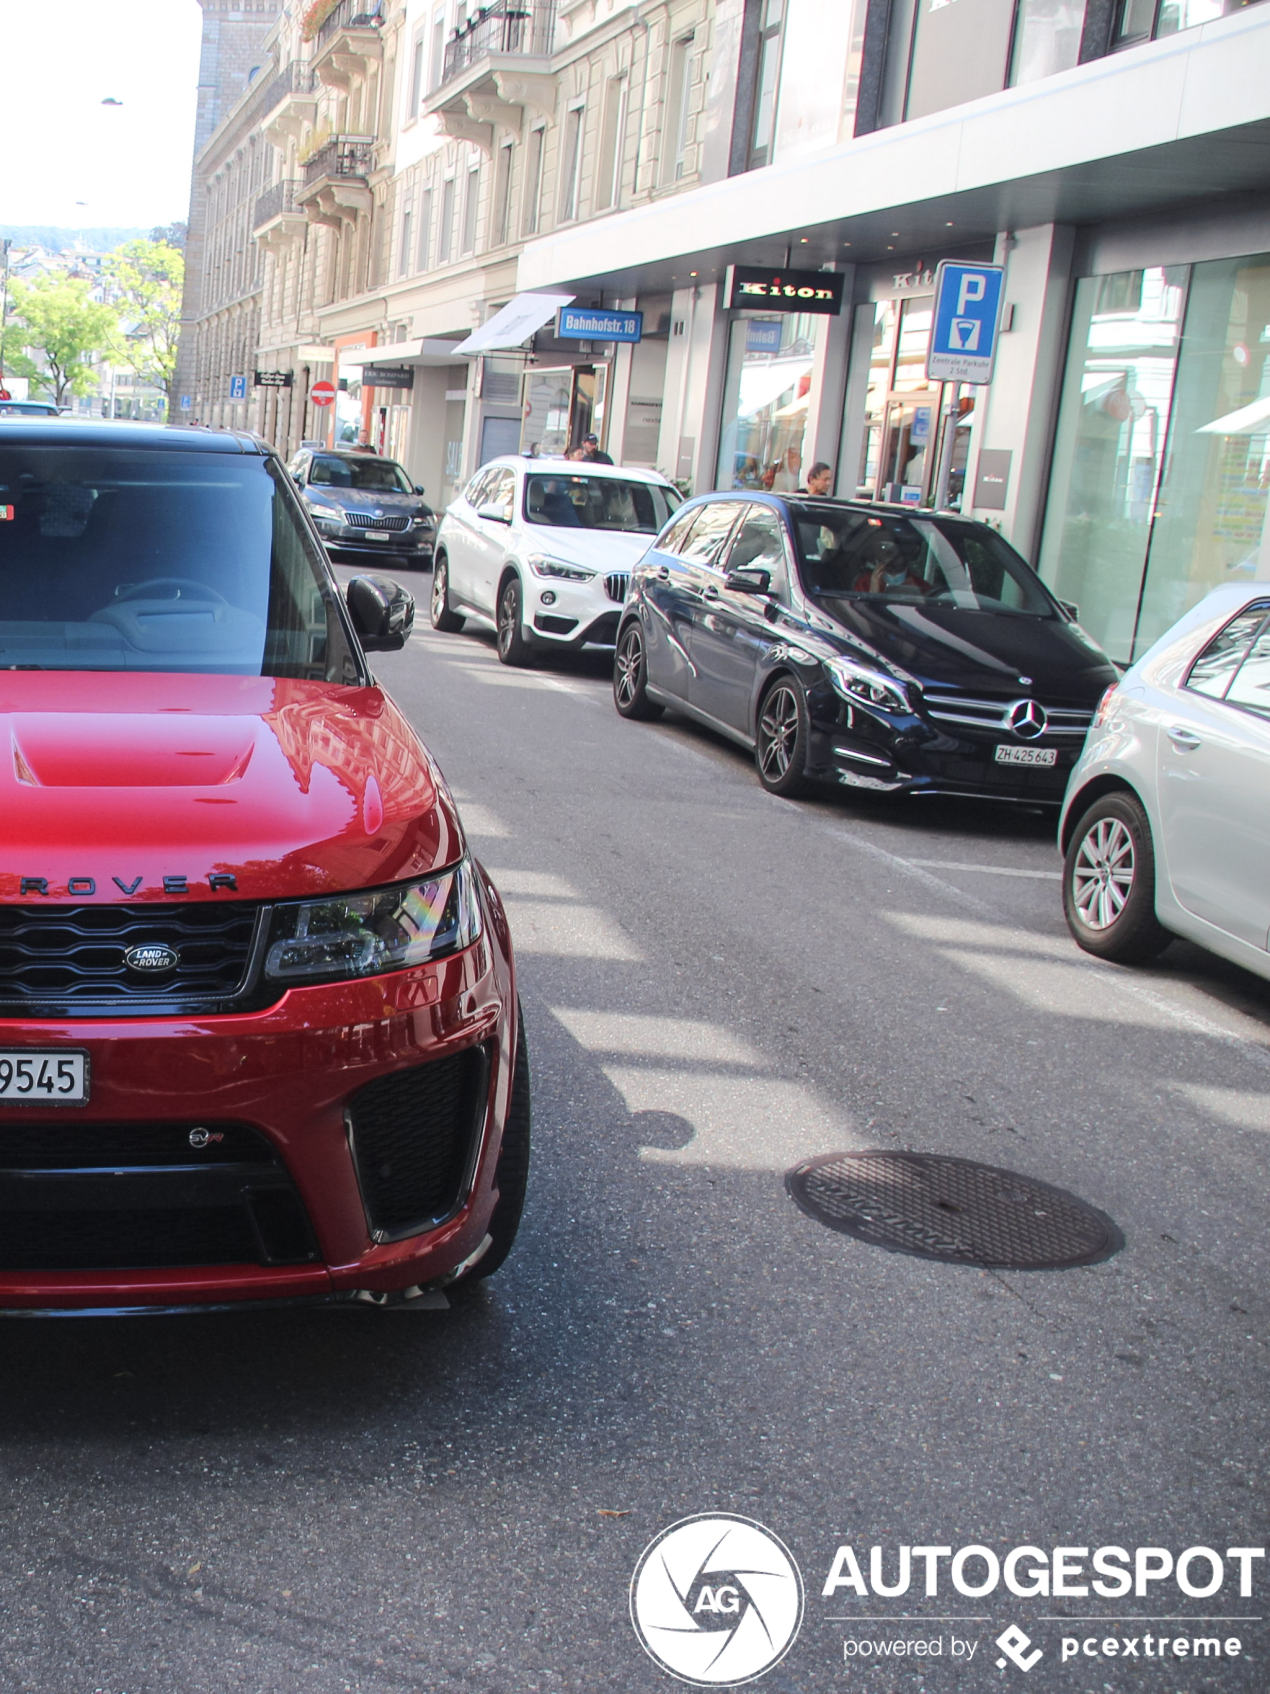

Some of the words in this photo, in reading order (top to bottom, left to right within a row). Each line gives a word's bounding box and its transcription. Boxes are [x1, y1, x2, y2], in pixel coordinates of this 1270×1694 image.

[739, 277, 834, 300] Kiton
[956, 273, 987, 316] P
[235, 378, 242, 389] P
[20, 873, 238, 896] ROVER
[136, 950, 162, 959] LAND
[138, 957, 170, 967] ROVER
